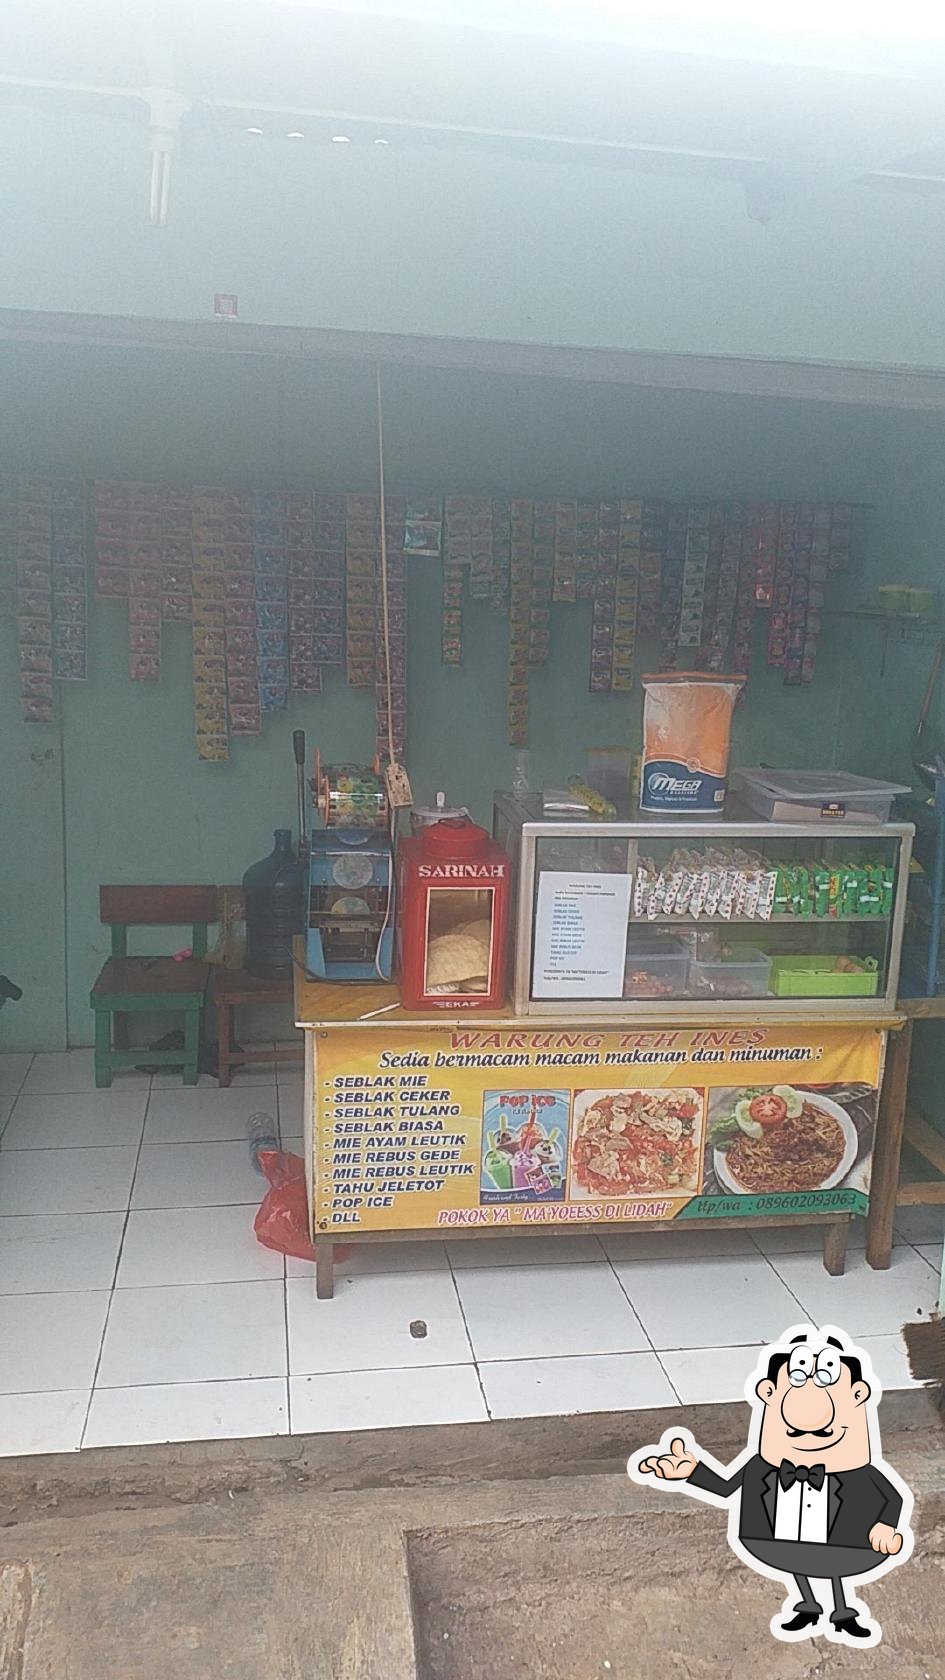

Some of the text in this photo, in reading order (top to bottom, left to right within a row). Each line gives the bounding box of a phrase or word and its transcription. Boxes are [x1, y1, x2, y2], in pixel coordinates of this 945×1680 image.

[651, 777, 702, 791] MEGA
[418, 864, 504, 878] SARINAH
[450, 1028, 768, 1049] WARUNG TEH INES
[379, 1051, 430, 1069] Sedia
[434, 1052, 530, 1068] bermacam
[534, 1052, 600, 1067] macam
[604, 1049, 687, 1065] makanan
[691, 1047, 725, 1063] dan
[729, 1045, 811, 1062] minuman
[334, 1075, 428, 1088] SEBLAK MIE
[334, 1090, 451, 1103] SEBLAK CEKER
[334, 1105, 461, 1118] SEBLAK TULANG
[333, 1120, 444, 1134] SEBLAK BIASA
[333, 1134, 467, 1149] MIE AYAM LEUTIK
[332, 1150, 461, 1165] MIE REBUS GEDE
[332, 1164, 474, 1180] MIE REBUS LEUTIK
[333, 1180, 445, 1194] TAHU JELETOT
[332, 1196, 393, 1209] POP ICE
[332, 1213, 361, 1223] DLL
[438, 1208, 488, 1224] POKOK
[492, 1207, 511, 1222] YA
[605, 1204, 621, 1218] DI
